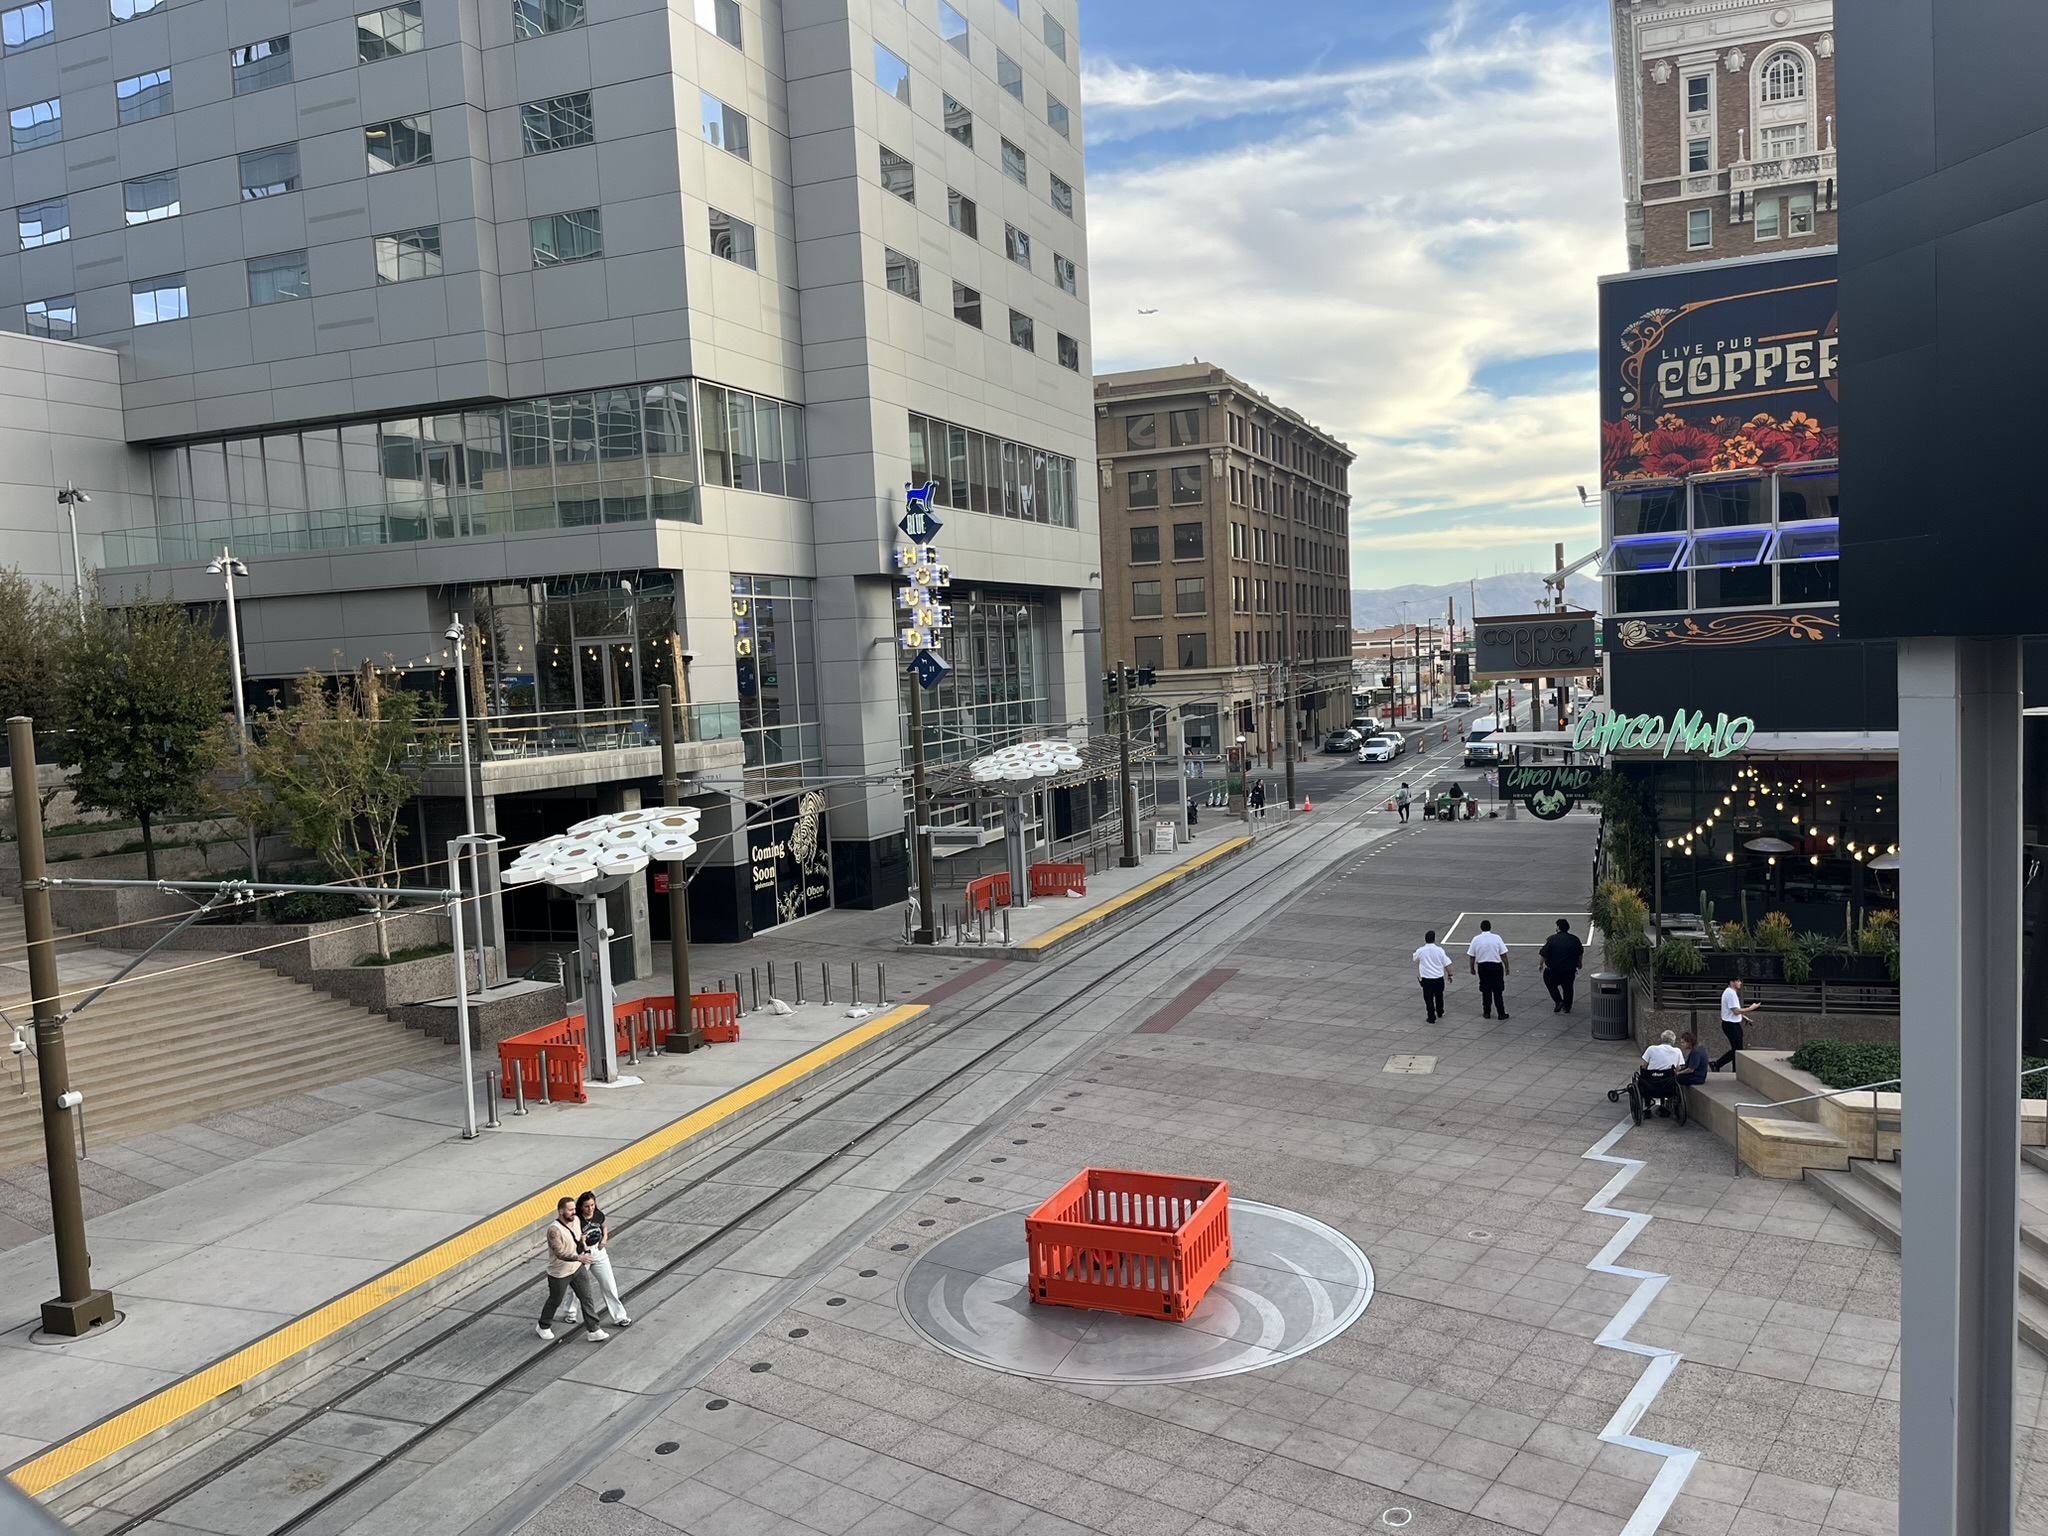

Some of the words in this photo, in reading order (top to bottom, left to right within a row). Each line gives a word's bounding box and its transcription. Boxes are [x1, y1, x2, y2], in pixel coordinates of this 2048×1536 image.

[1662, 344, 1703, 360] LIVE
[1717, 337, 1752, 351] PUB
[906, 513, 926, 535] BLUE
[902, 546, 933, 648] HOUND
[1482, 624, 1577, 652] copper
[1513, 643, 1588, 667] blues
[752, 840, 786, 862] Coming
[753, 866, 775, 883] Soon
[806, 885, 825, 897] Obon
